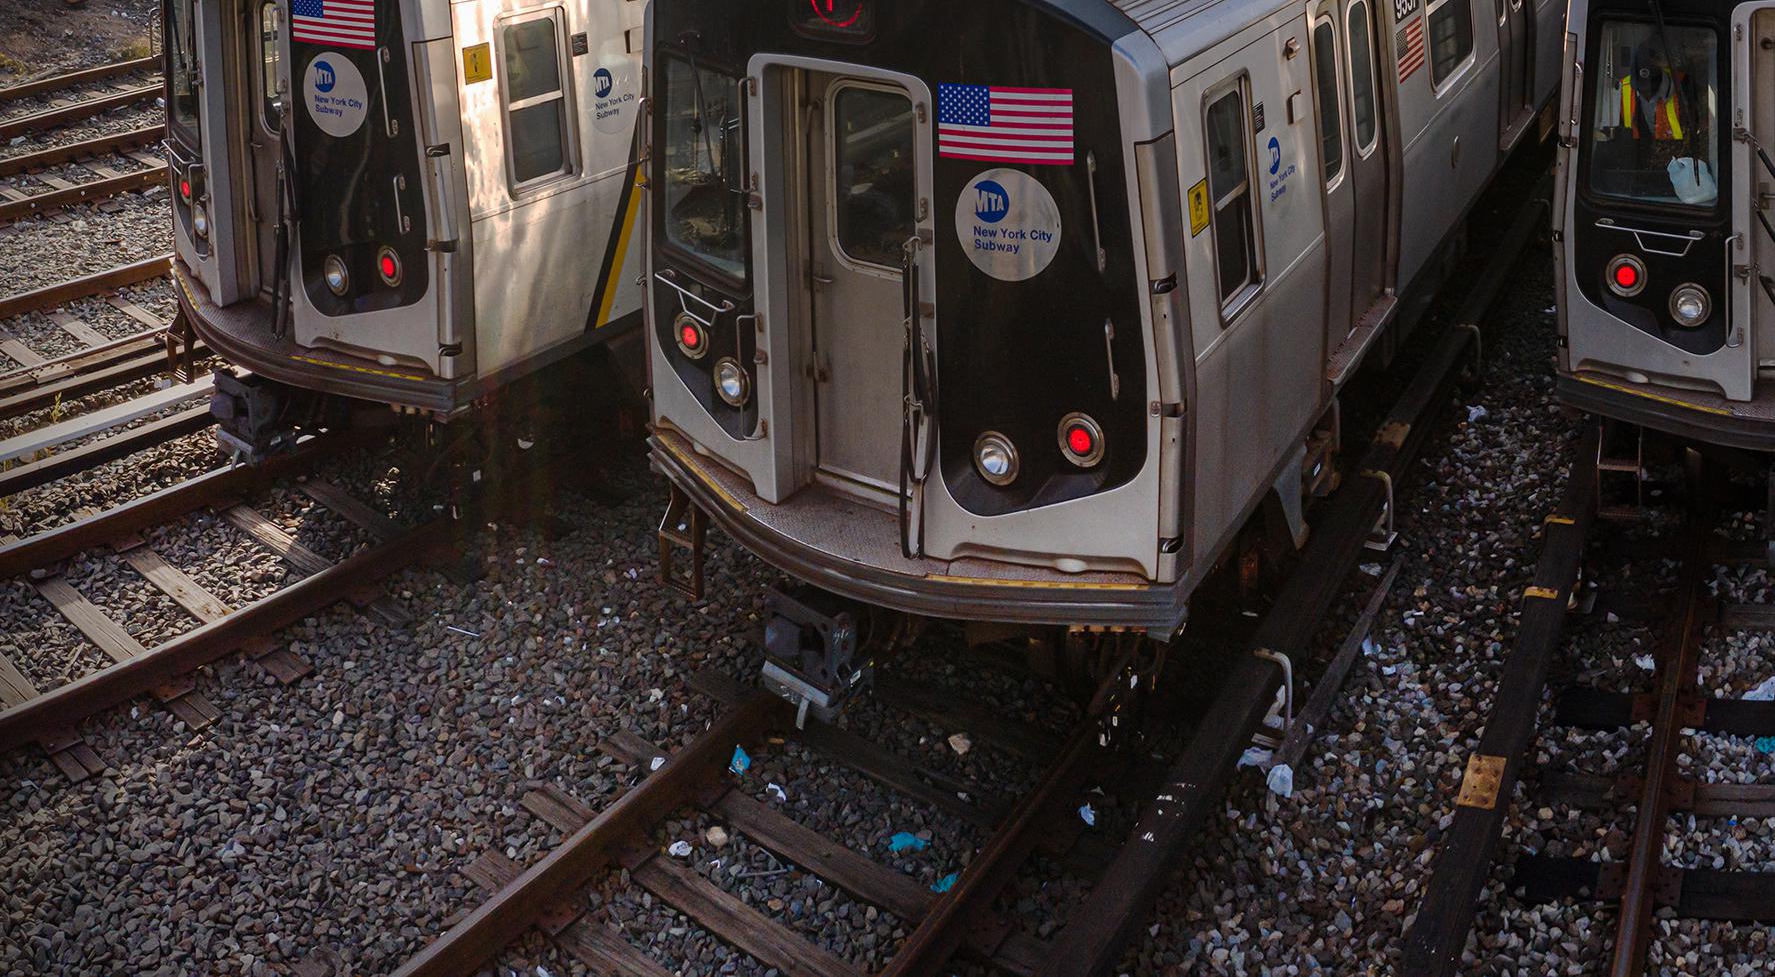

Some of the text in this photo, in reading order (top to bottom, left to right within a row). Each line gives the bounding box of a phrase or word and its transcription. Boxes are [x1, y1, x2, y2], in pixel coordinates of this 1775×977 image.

[315, 94, 362, 110] New York City
[595, 93, 635, 110] New York City
[315, 104, 343, 117] Subway
[596, 108, 619, 120] Subway
[975, 189, 1004, 213] MTA
[973, 226, 1053, 243] New York City
[974, 239, 1020, 254] Subway
